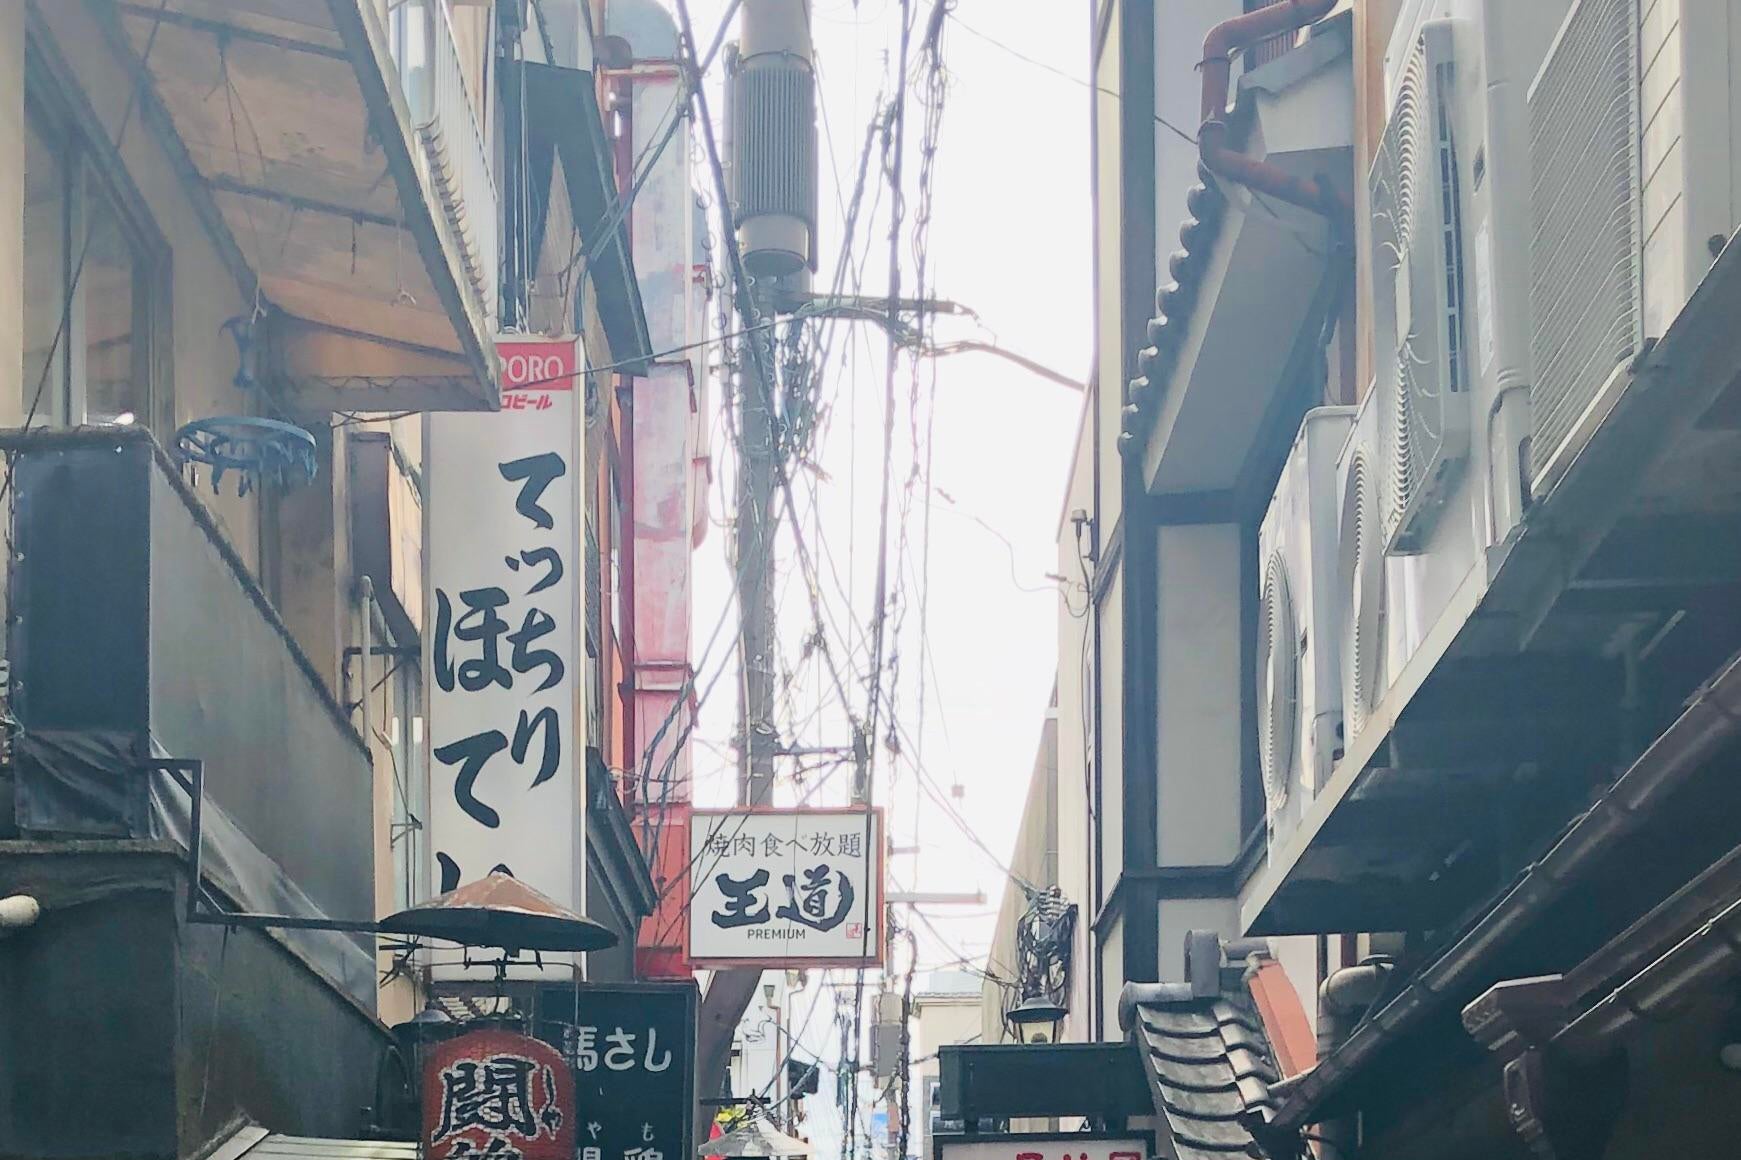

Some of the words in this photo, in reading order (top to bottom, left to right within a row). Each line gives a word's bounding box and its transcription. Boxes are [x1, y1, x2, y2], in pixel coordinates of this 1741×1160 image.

[499, 452, 567, 789] てっちり
[706, 831, 862, 858] 焼肉食べ放題
[711, 863, 855, 933] 王道
[747, 929, 806, 940] PREMIUM
